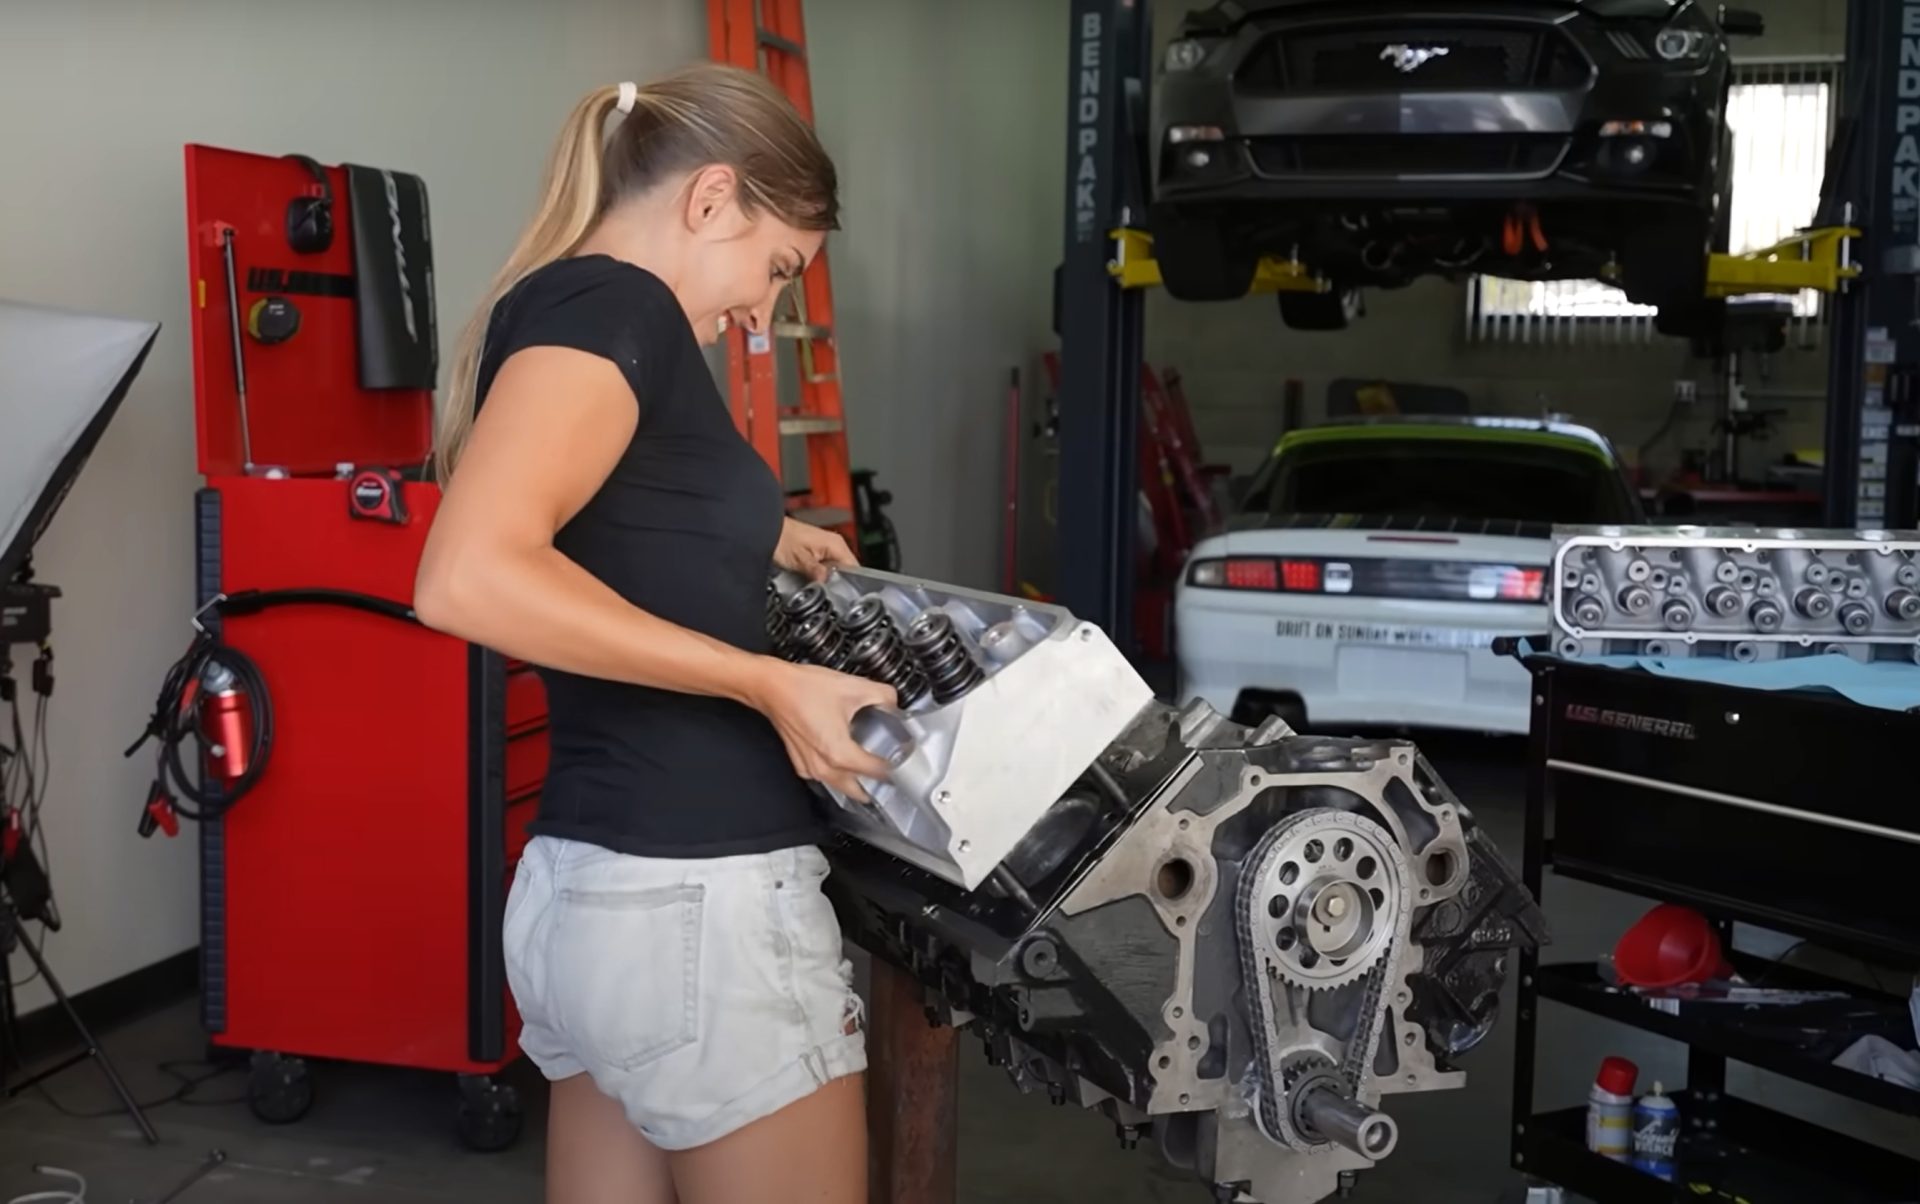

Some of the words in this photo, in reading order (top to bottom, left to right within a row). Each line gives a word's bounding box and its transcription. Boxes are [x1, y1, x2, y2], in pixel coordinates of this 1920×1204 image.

[1076, 12, 1102, 208] BENDPAK
[1892, 0, 1920, 196] ENDPAK
[1276, 620, 1310, 638] DRIFT
[1316, 622, 1333, 639] ON
